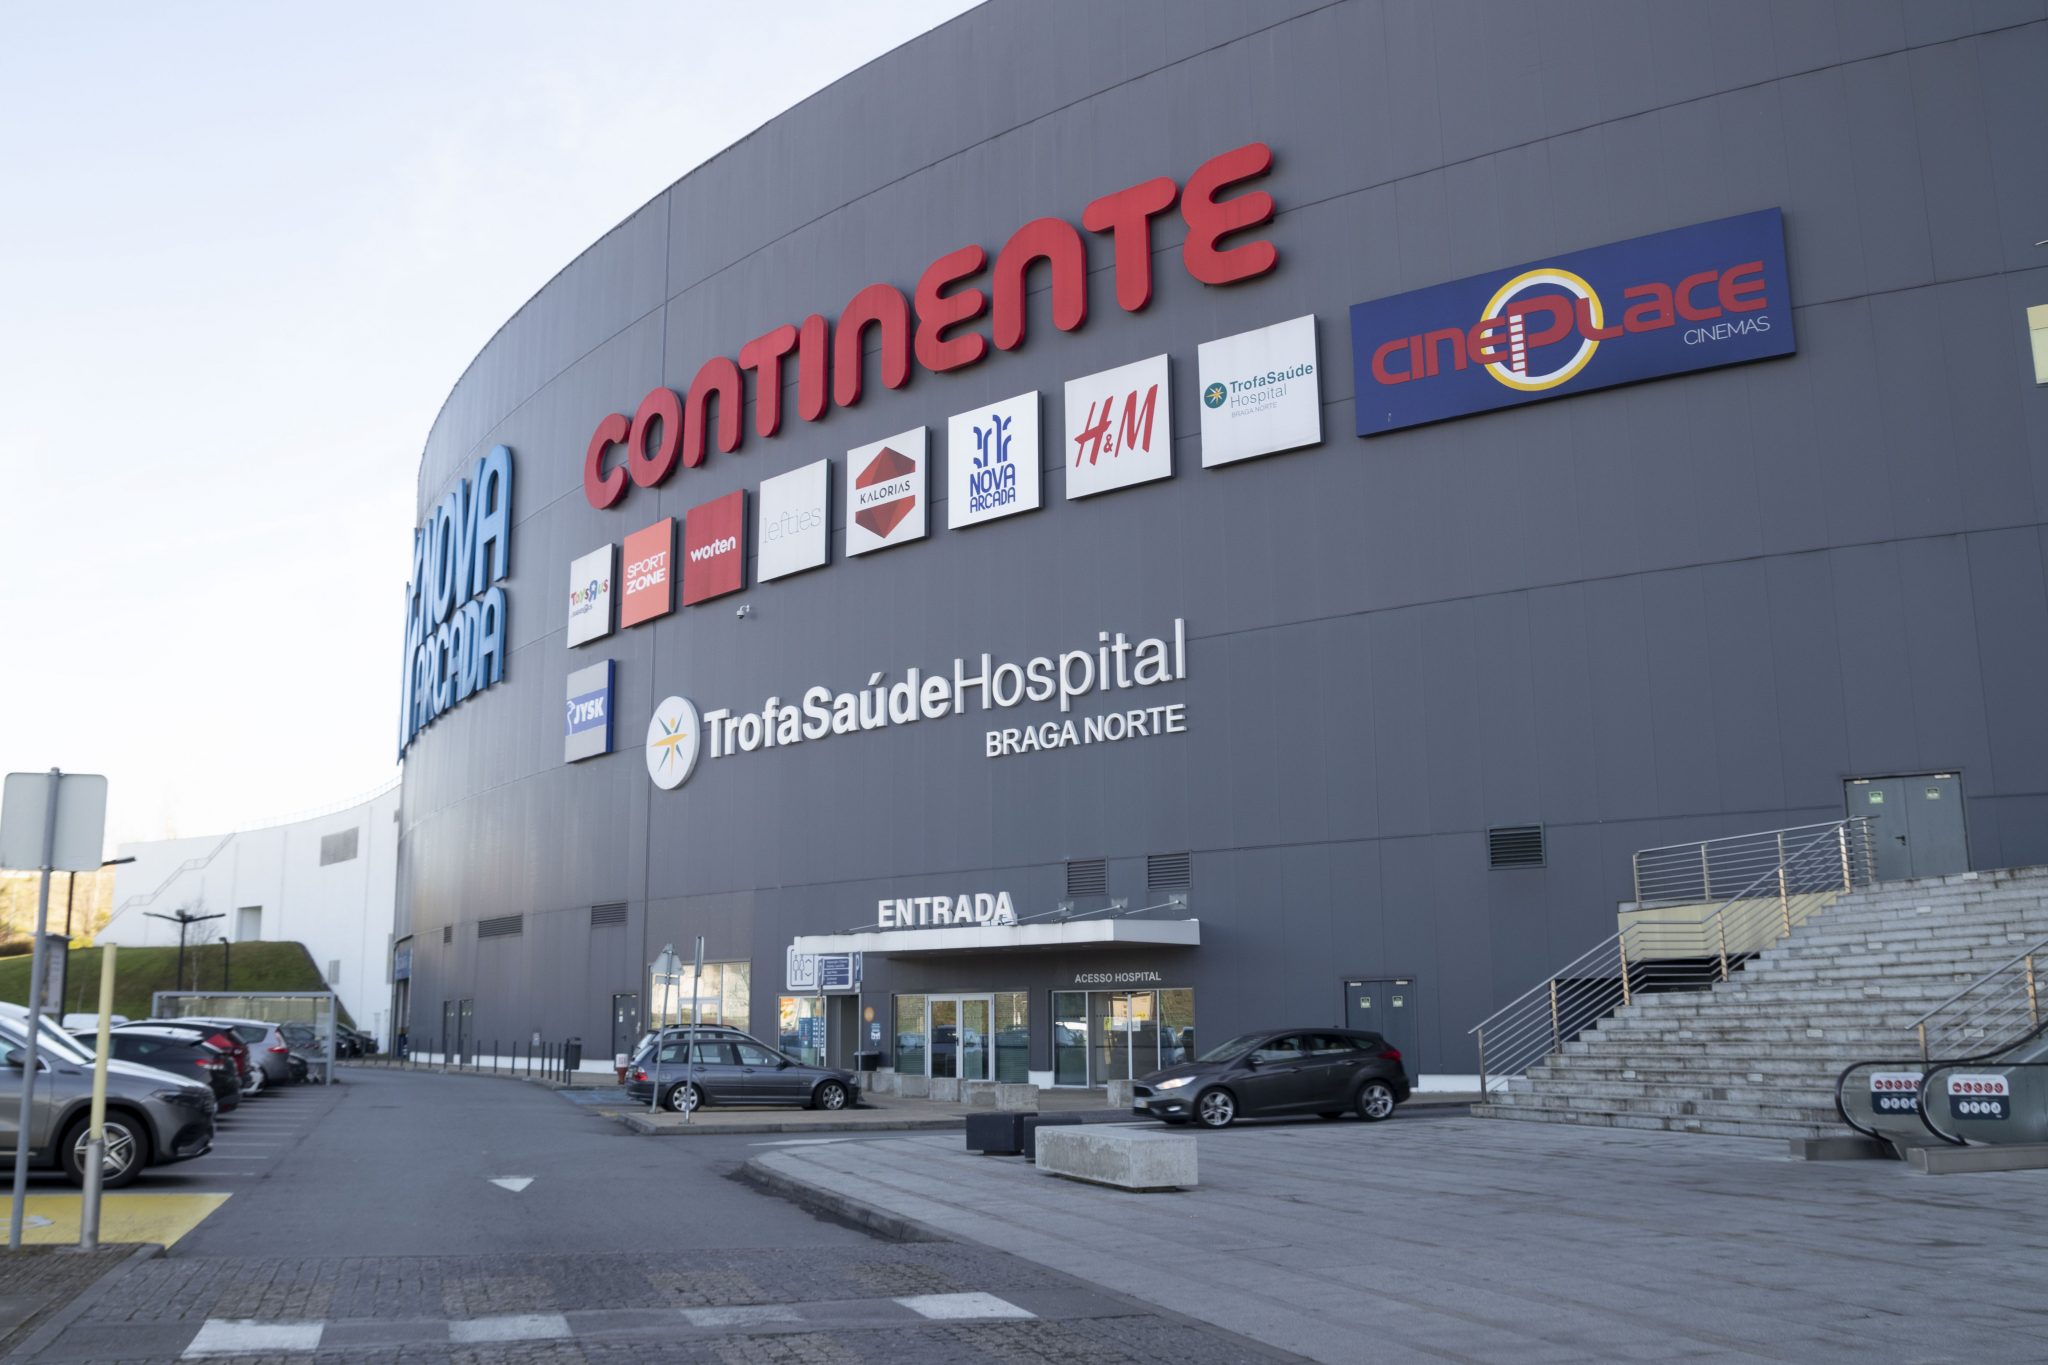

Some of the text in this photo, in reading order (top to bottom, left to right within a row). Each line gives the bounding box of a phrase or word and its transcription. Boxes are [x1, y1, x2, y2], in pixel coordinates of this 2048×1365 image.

[584, 142, 1278, 509] CONTINENTE
[1684, 316, 1770, 346] CINEMAS
[1229, 363, 1314, 394] TrofaSaúde
[1231, 383, 1287, 408] Hospital
[1074, 384, 1158, 467] H&M
[860, 480, 911, 504] KALORIAS
[970, 463, 1016, 497] NOVA
[970, 486, 1016, 513] ARCADA
[763, 507, 822, 543] lefties
[418, 443, 513, 644] NOVA
[690, 536, 736, 562] worten
[627, 551, 667, 579] SPORT
[626, 567, 667, 595] ZONE
[414, 587, 507, 736] ARCADA
[573, 696, 604, 725] JYSK
[986, 704, 1187, 757] BRAGA NORTE
[878, 891, 1016, 927] ENTRADA
[1075, 972, 1162, 983] ACESSO HOSPITAL
